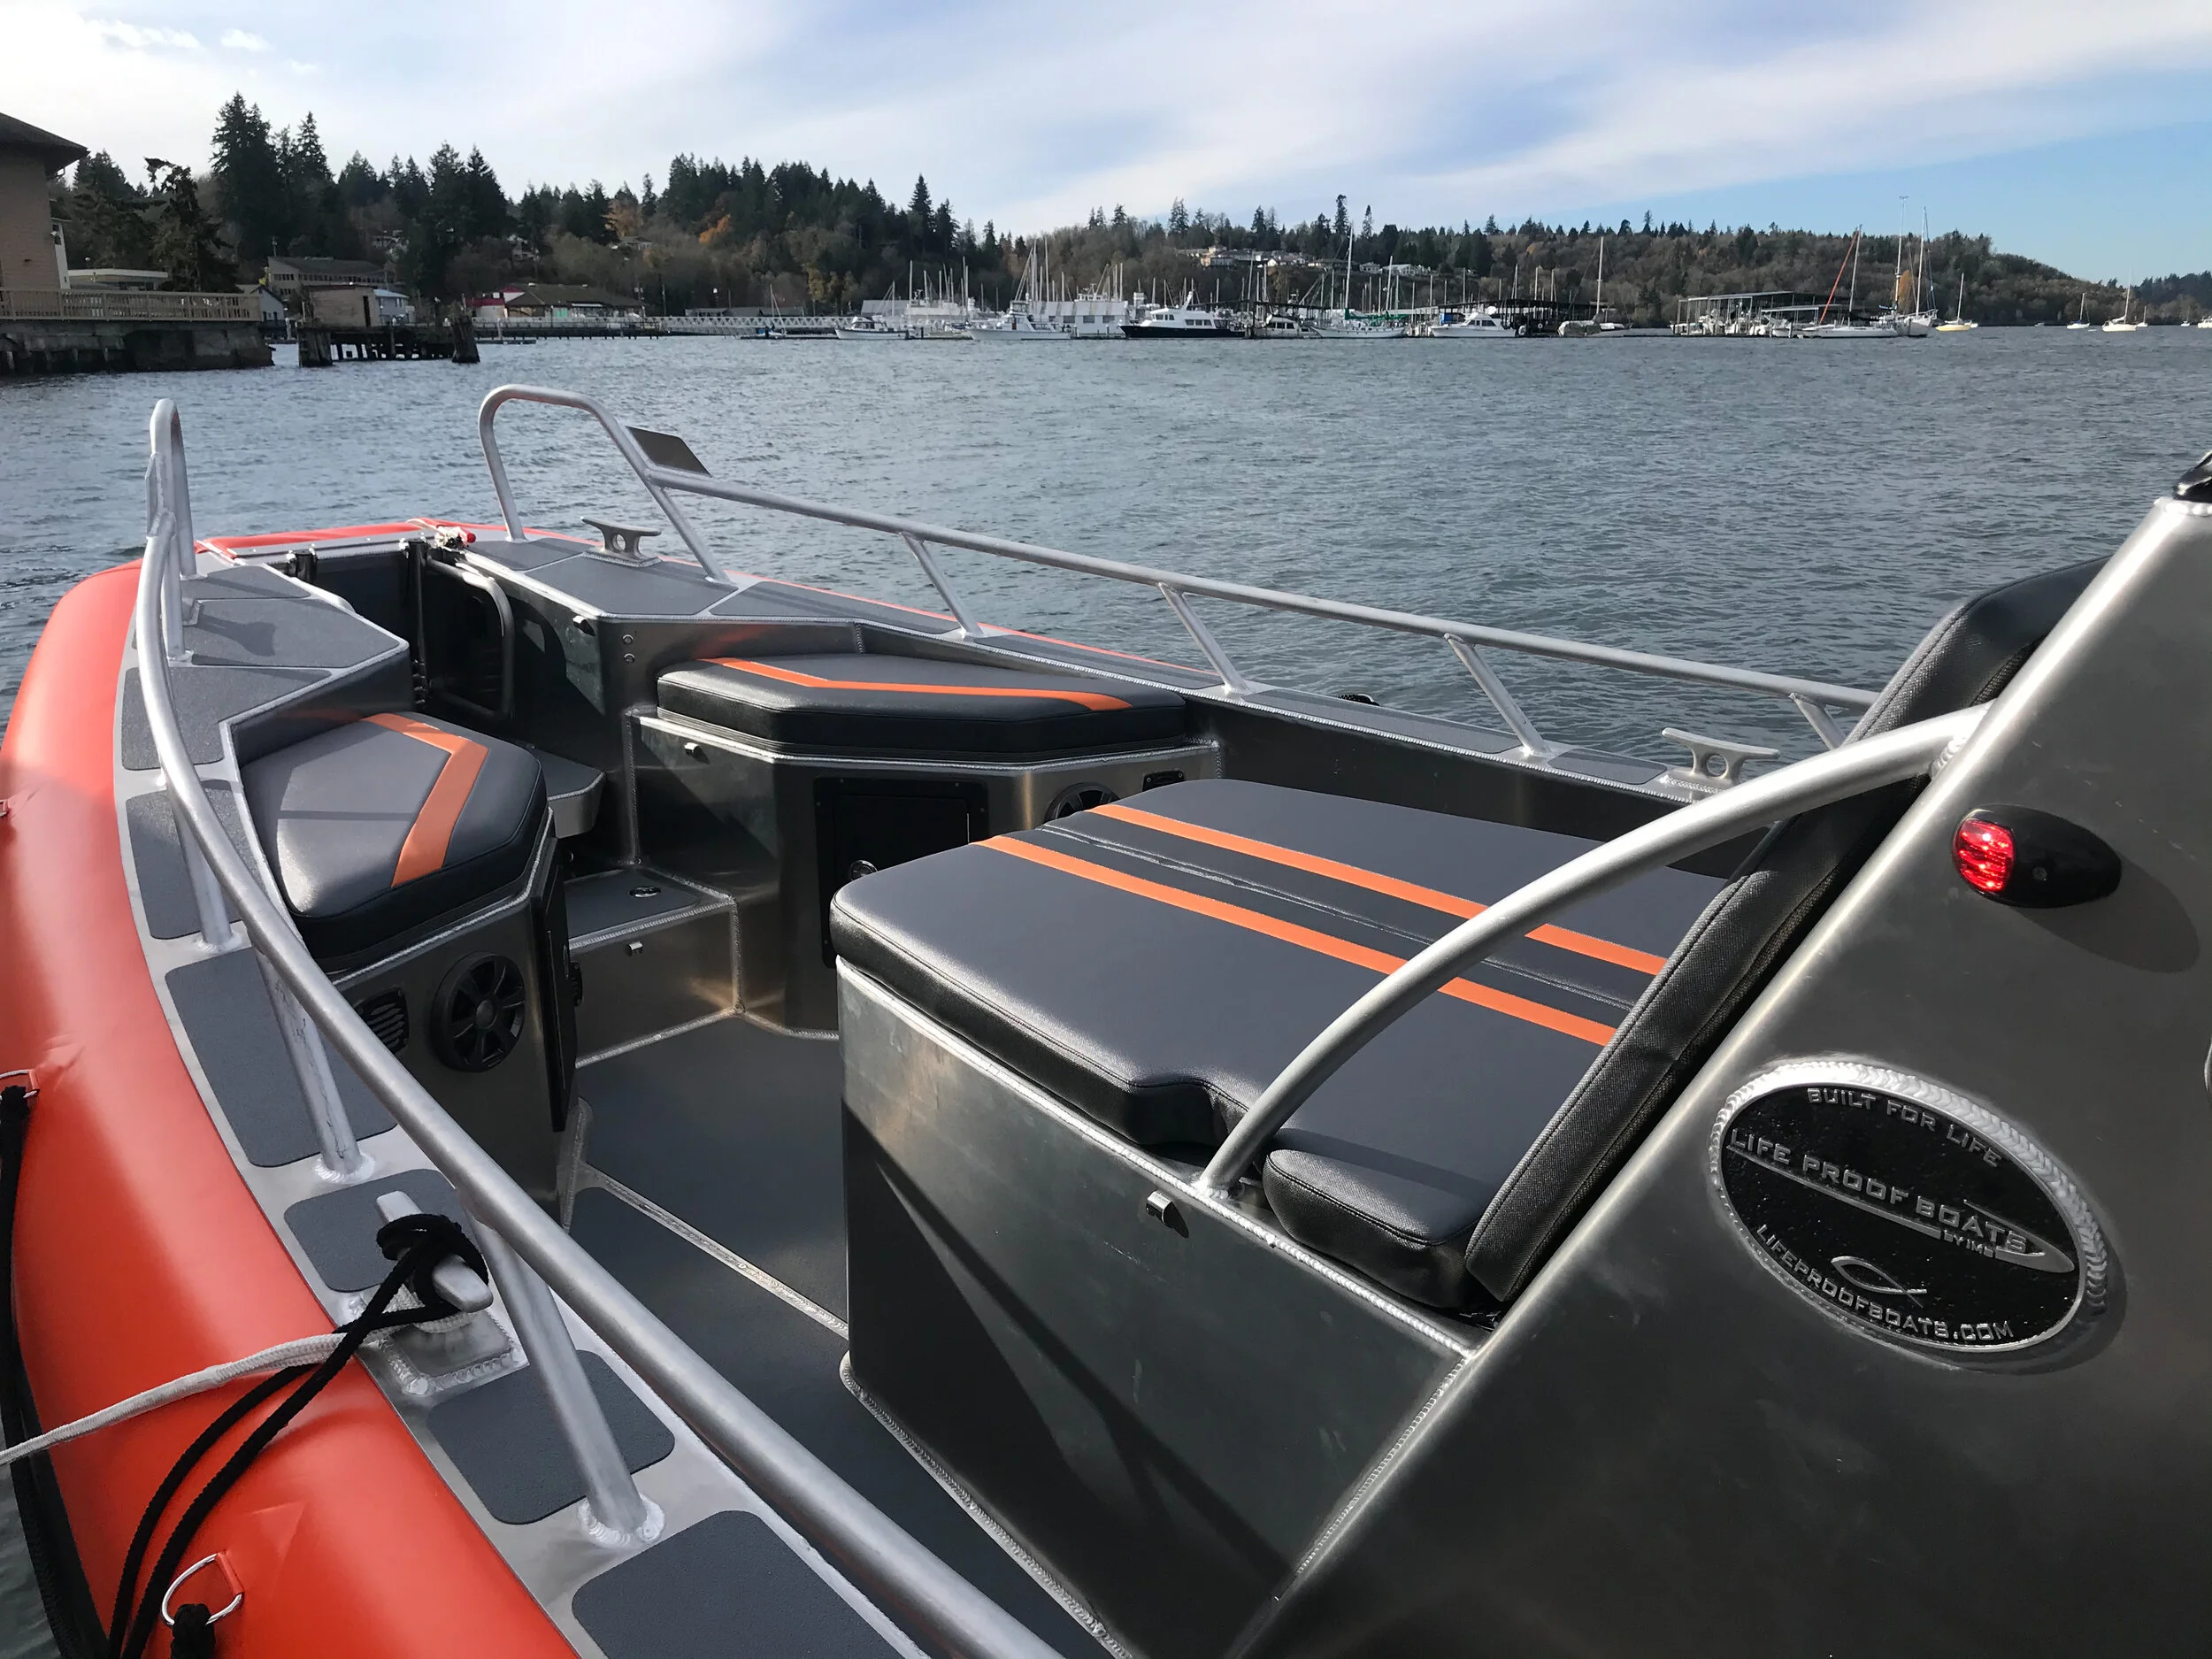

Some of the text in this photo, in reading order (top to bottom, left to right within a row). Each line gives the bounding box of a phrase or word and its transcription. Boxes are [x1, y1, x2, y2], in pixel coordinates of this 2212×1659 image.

[1808, 1087, 2002, 1168] BUILT FOR LIFE
[1730, 1128, 2028, 1254] LIFE PROOF BOATS
[1756, 1224, 2014, 1341] LIFEPROOFBOATS.COM
